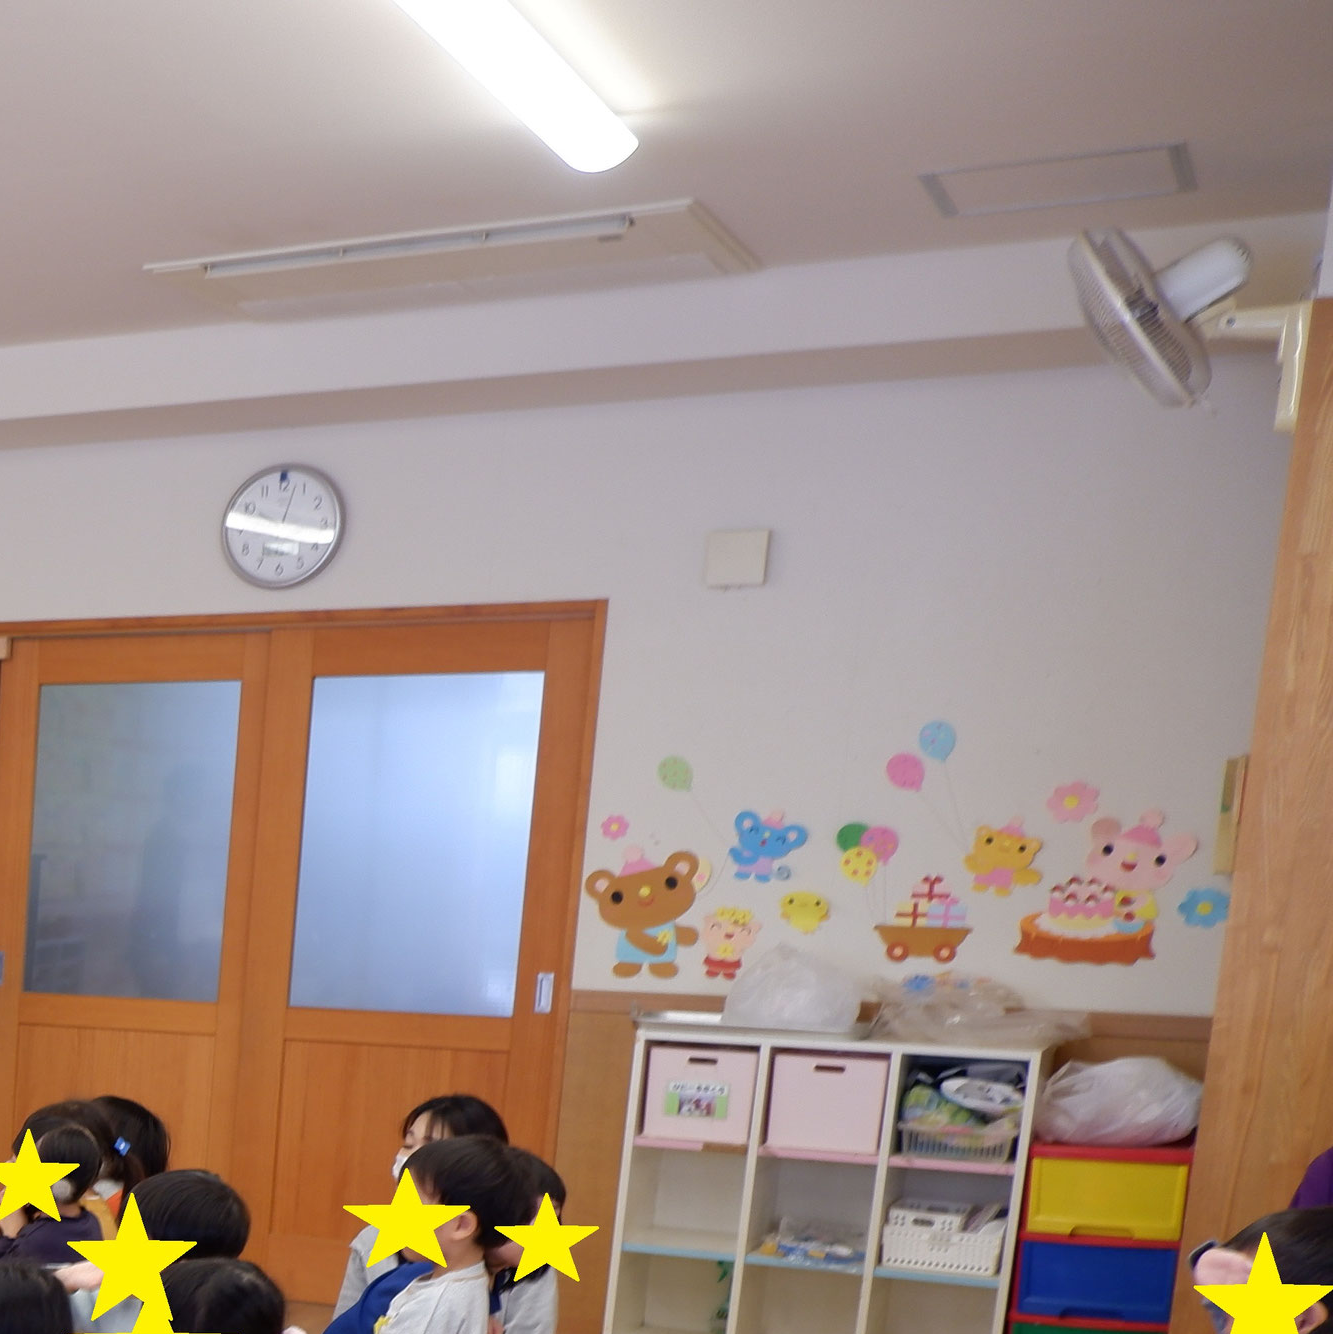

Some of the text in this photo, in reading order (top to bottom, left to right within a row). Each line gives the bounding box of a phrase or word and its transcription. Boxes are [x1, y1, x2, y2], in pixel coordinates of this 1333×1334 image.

[261, 485, 269, 498] 11
[244, 501, 256, 516] 10
[313, 495, 322, 511] 2
[319, 517, 329, 530] 3
[241, 543, 250, 557] 8
[256, 558, 264, 570] 7
[275, 563, 284, 576] 6
[297, 557, 305, 570] 5
